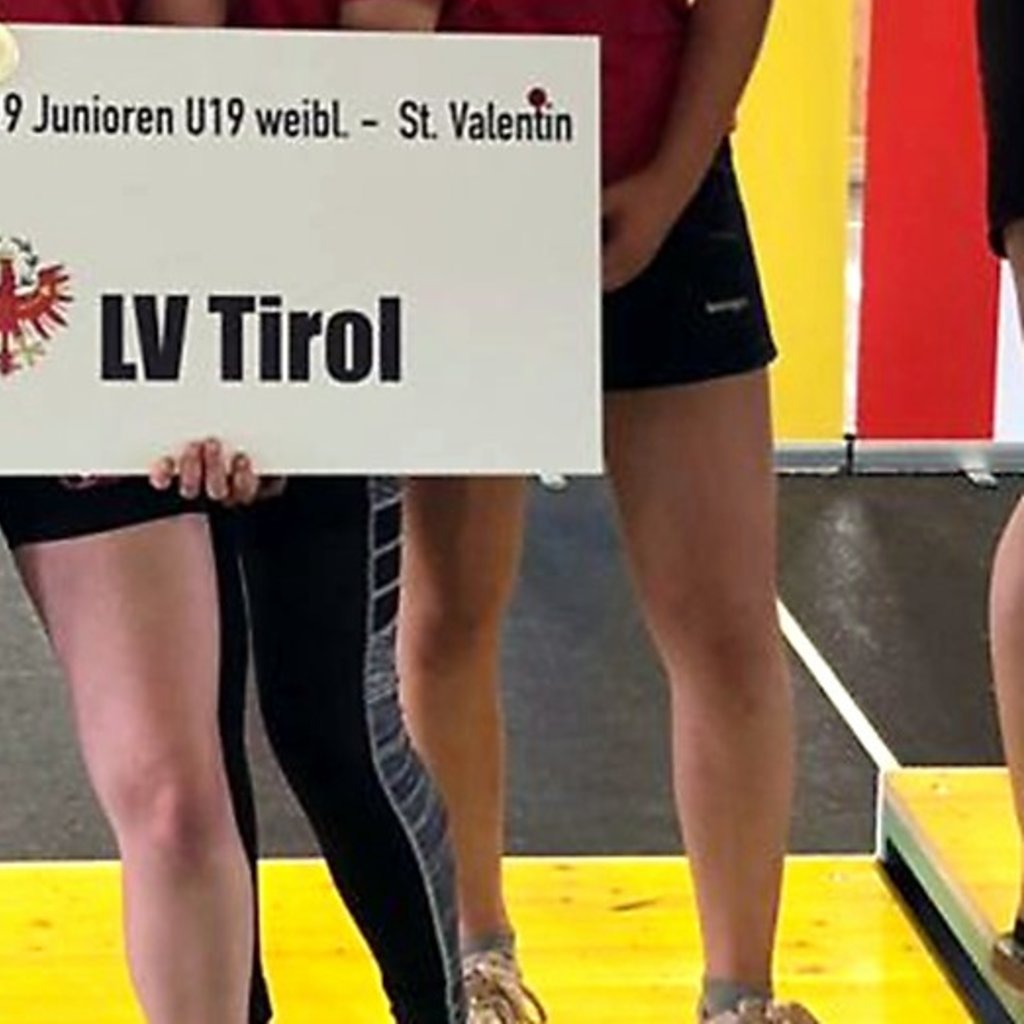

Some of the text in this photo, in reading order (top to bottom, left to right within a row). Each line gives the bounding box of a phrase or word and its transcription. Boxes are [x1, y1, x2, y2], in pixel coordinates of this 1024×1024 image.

[32, 94, 174, 136] Junioren
[186, 97, 244, 137] U19
[254, 98, 348, 139] weibl.
[398, 100, 438, 140] St.
[450, 101, 573, 142] Valentin
[101, 294, 402, 383] LV Tirol
